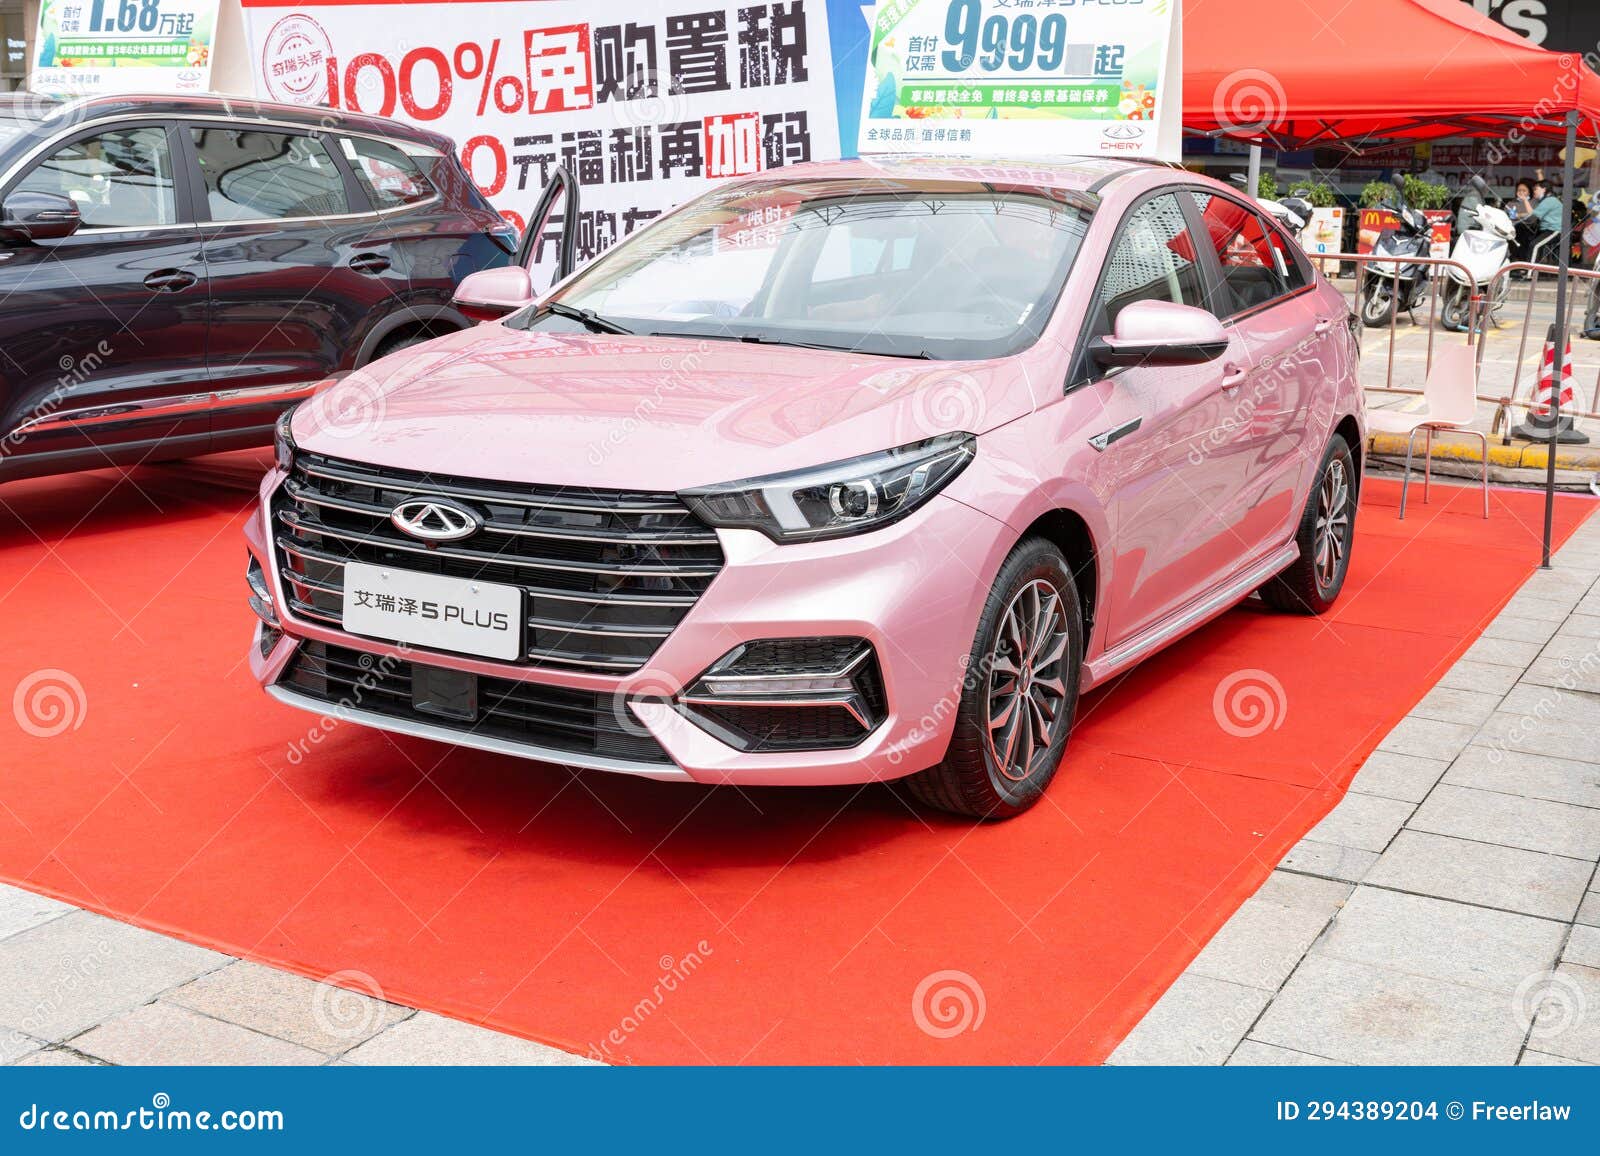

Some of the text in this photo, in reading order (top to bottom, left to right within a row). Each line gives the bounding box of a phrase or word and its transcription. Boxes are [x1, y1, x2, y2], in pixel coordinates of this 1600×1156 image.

[908, 36, 938, 52] 首付
[272, 50, 322, 76] 奇瑞头条
[905, 55, 936, 71] 仅需
[911, 90, 983, 103] 享购置税全免
[867, 128, 972, 142] 全球品质 值得信赖
[1100, 142, 1143, 150] CHERY
[353, 590, 508, 631] 艾瑞泽5 PLUS
